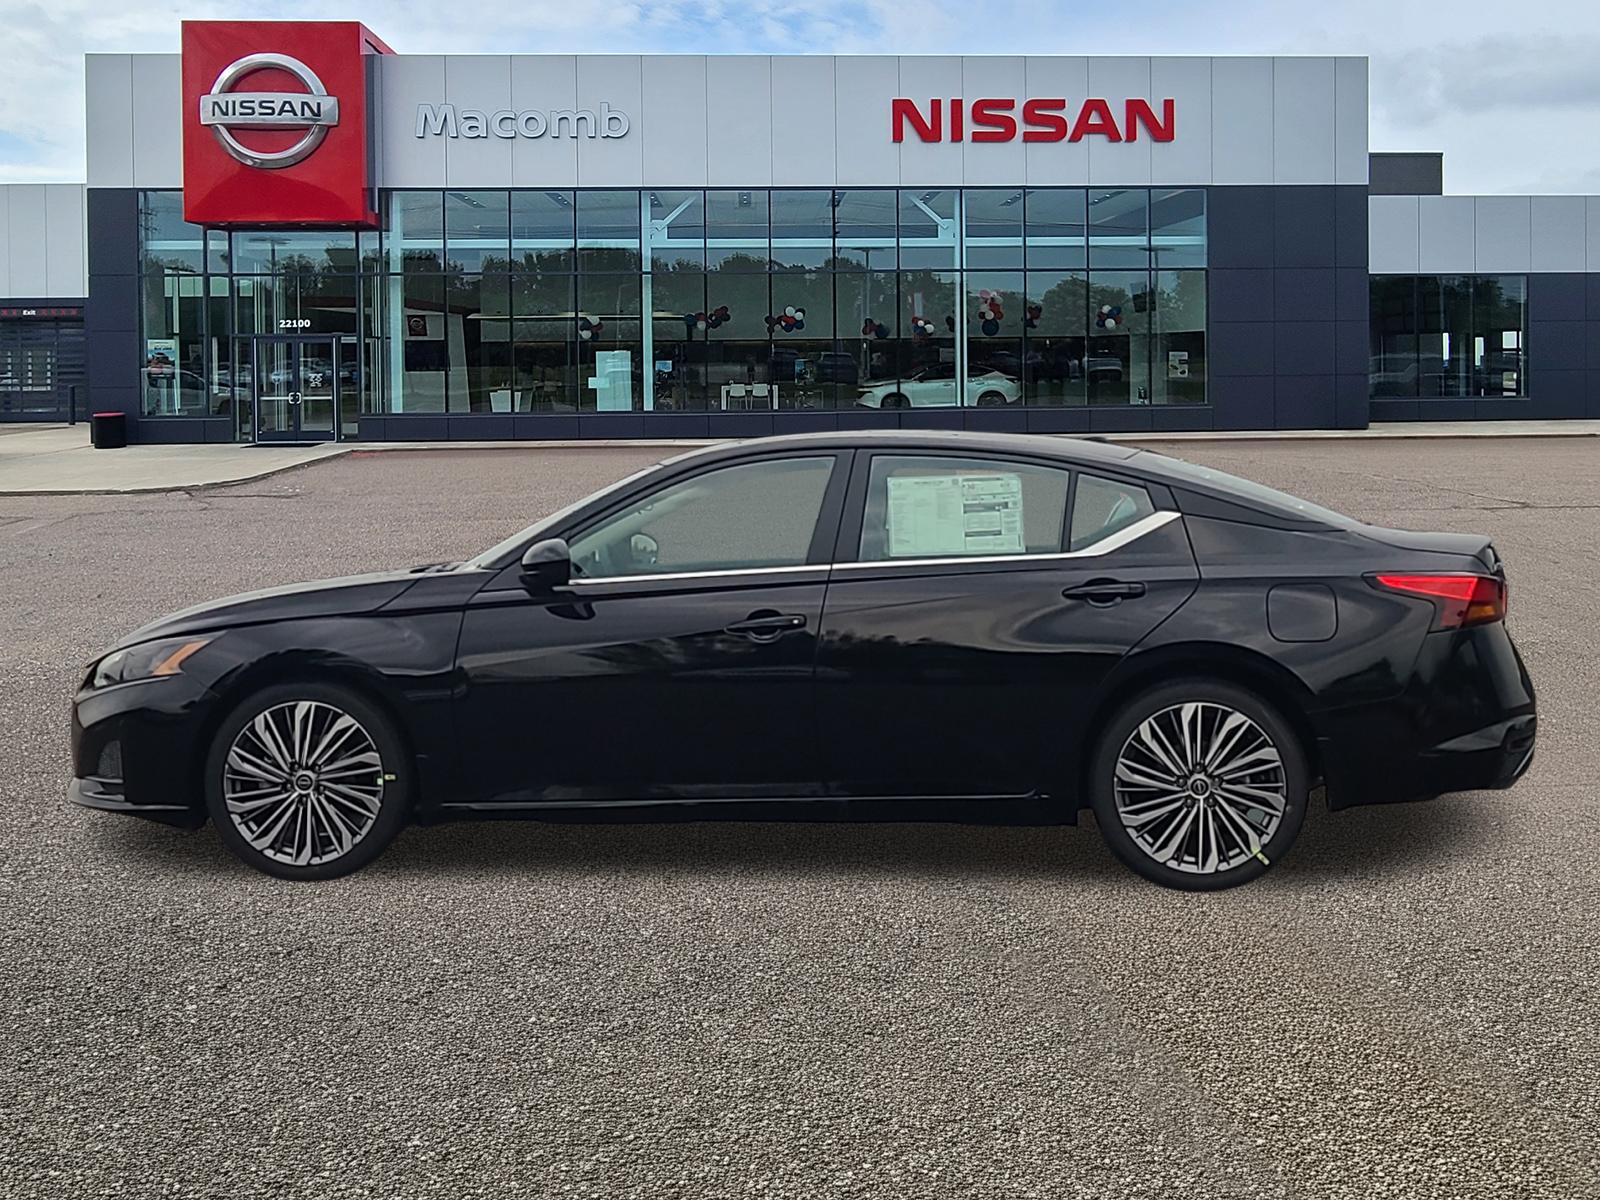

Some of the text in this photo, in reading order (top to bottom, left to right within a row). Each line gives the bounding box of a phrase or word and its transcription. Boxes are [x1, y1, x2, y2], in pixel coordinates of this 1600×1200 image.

[211, 100, 322, 118] NISSAN
[415, 101, 630, 138] Macomb
[892, 98, 1175, 143] NISSAN
[279, 319, 311, 328] 22100
